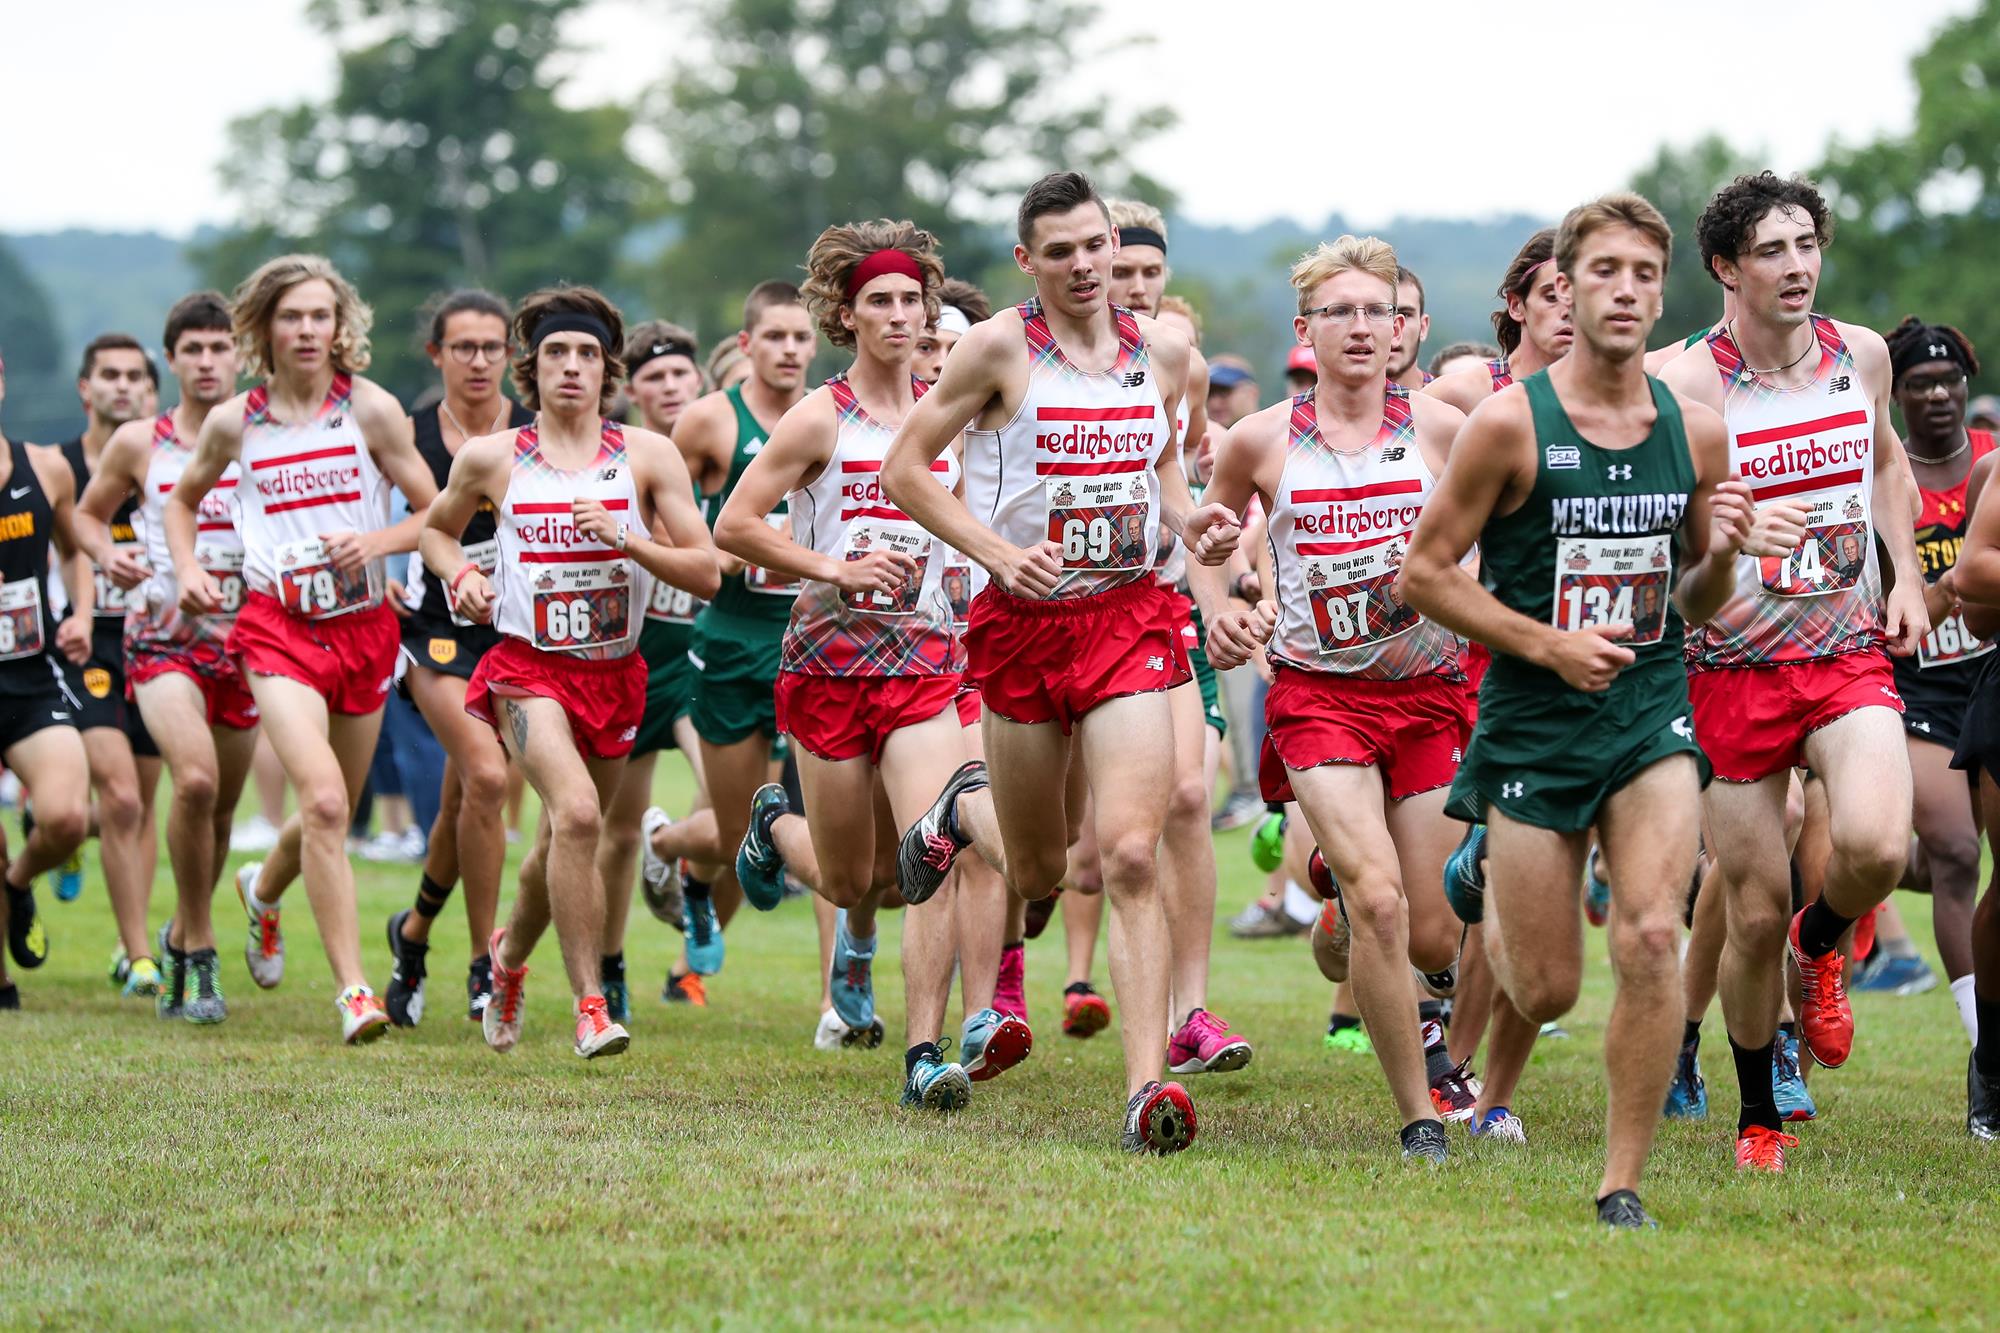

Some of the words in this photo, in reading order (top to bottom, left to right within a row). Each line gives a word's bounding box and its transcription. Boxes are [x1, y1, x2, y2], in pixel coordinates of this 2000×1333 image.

[1046, 424, 1148, 459] edinboro
[1549, 452, 1579, 462] PSAC
[1751, 439, 1865, 479] edinboro
[260, 467, 351, 495] edinboro
[1083, 484, 1102, 493] Doug
[1103, 482, 1123, 492] Watts
[1095, 494, 1114, 504] Open
[1551, 493, 1689, 534] MERCYHURST
[1303, 504, 1414, 538] edinboro
[1806, 514, 1824, 525] pen
[879, 531, 898, 542] Doug
[898, 534, 920, 546] Watts
[1063, 517, 1111, 561] 69
[1600, 548, 1621, 559] Doug
[1623, 547, 1644, 558] Watts
[1332, 561, 1351, 572] Doug
[1352, 554, 1375, 567] Watts
[1347, 569, 1367, 580] Open
[292, 570, 337, 613] 79
[546, 599, 591, 641] 66
[1326, 590, 1370, 641] 87
[1563, 586, 1634, 631] 134
